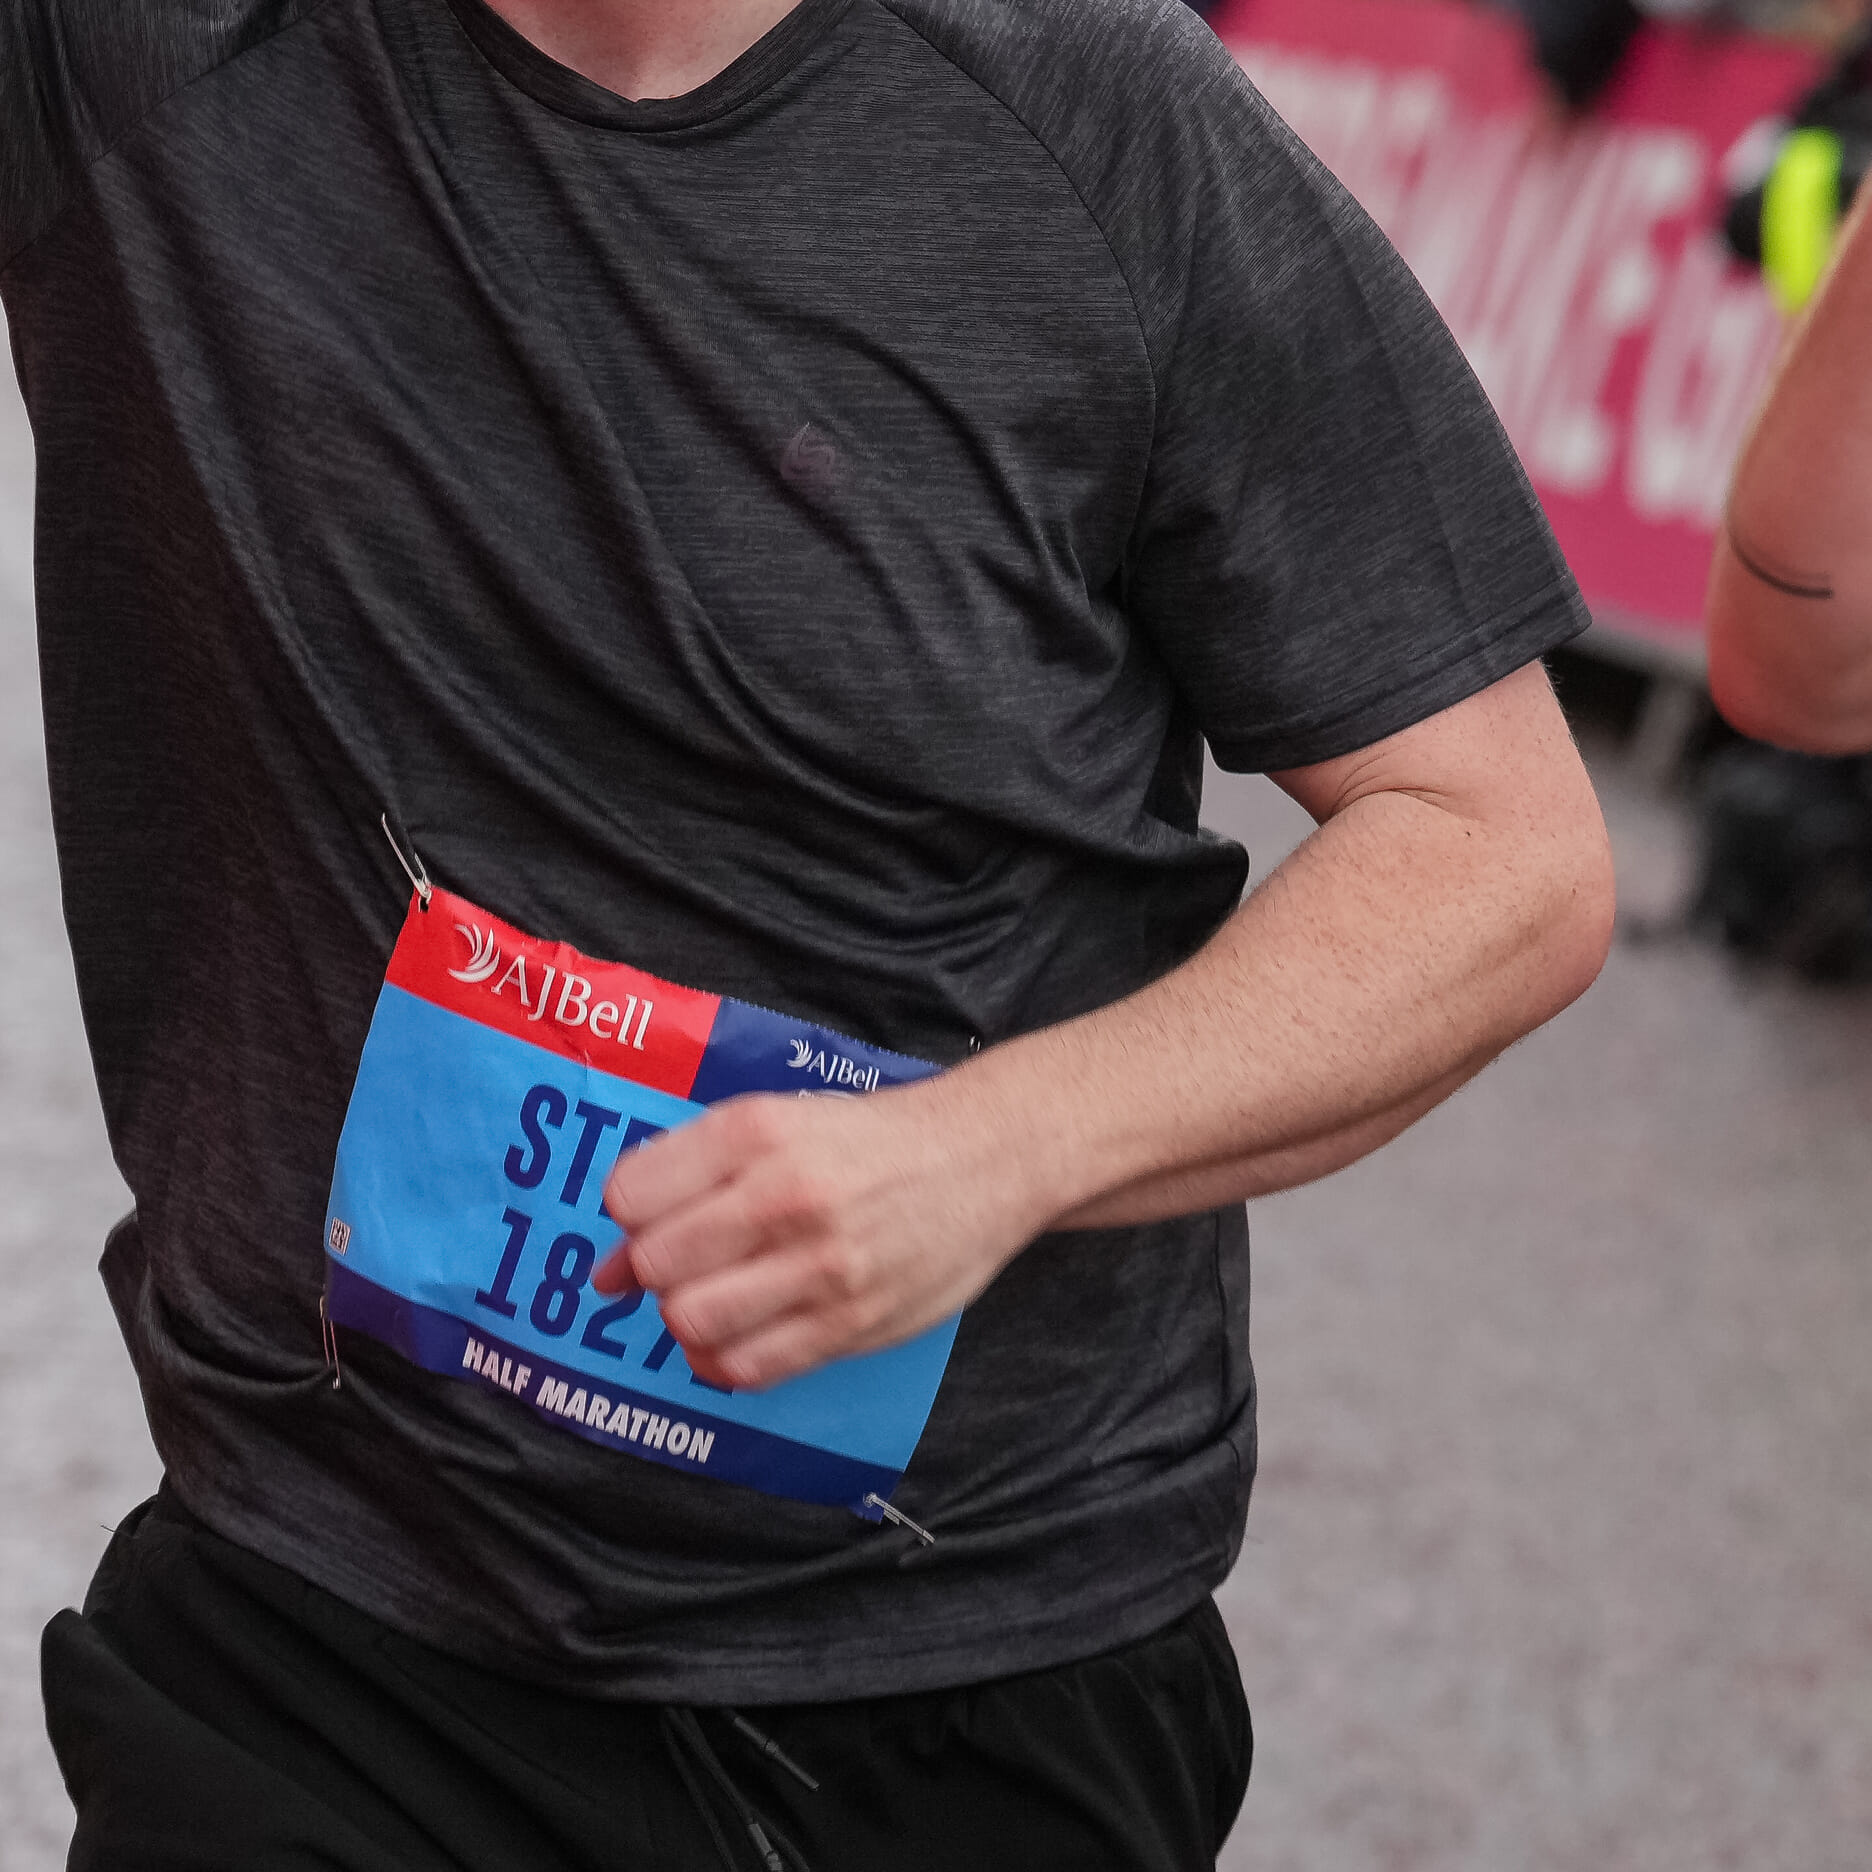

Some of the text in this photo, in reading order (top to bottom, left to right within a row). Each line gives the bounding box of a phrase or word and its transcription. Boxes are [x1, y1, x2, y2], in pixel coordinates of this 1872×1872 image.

[490, 964, 653, 1051] AJBell
[807, 1050, 880, 1093] AJBell
[462, 1336, 715, 1464] HALF MARATHON
